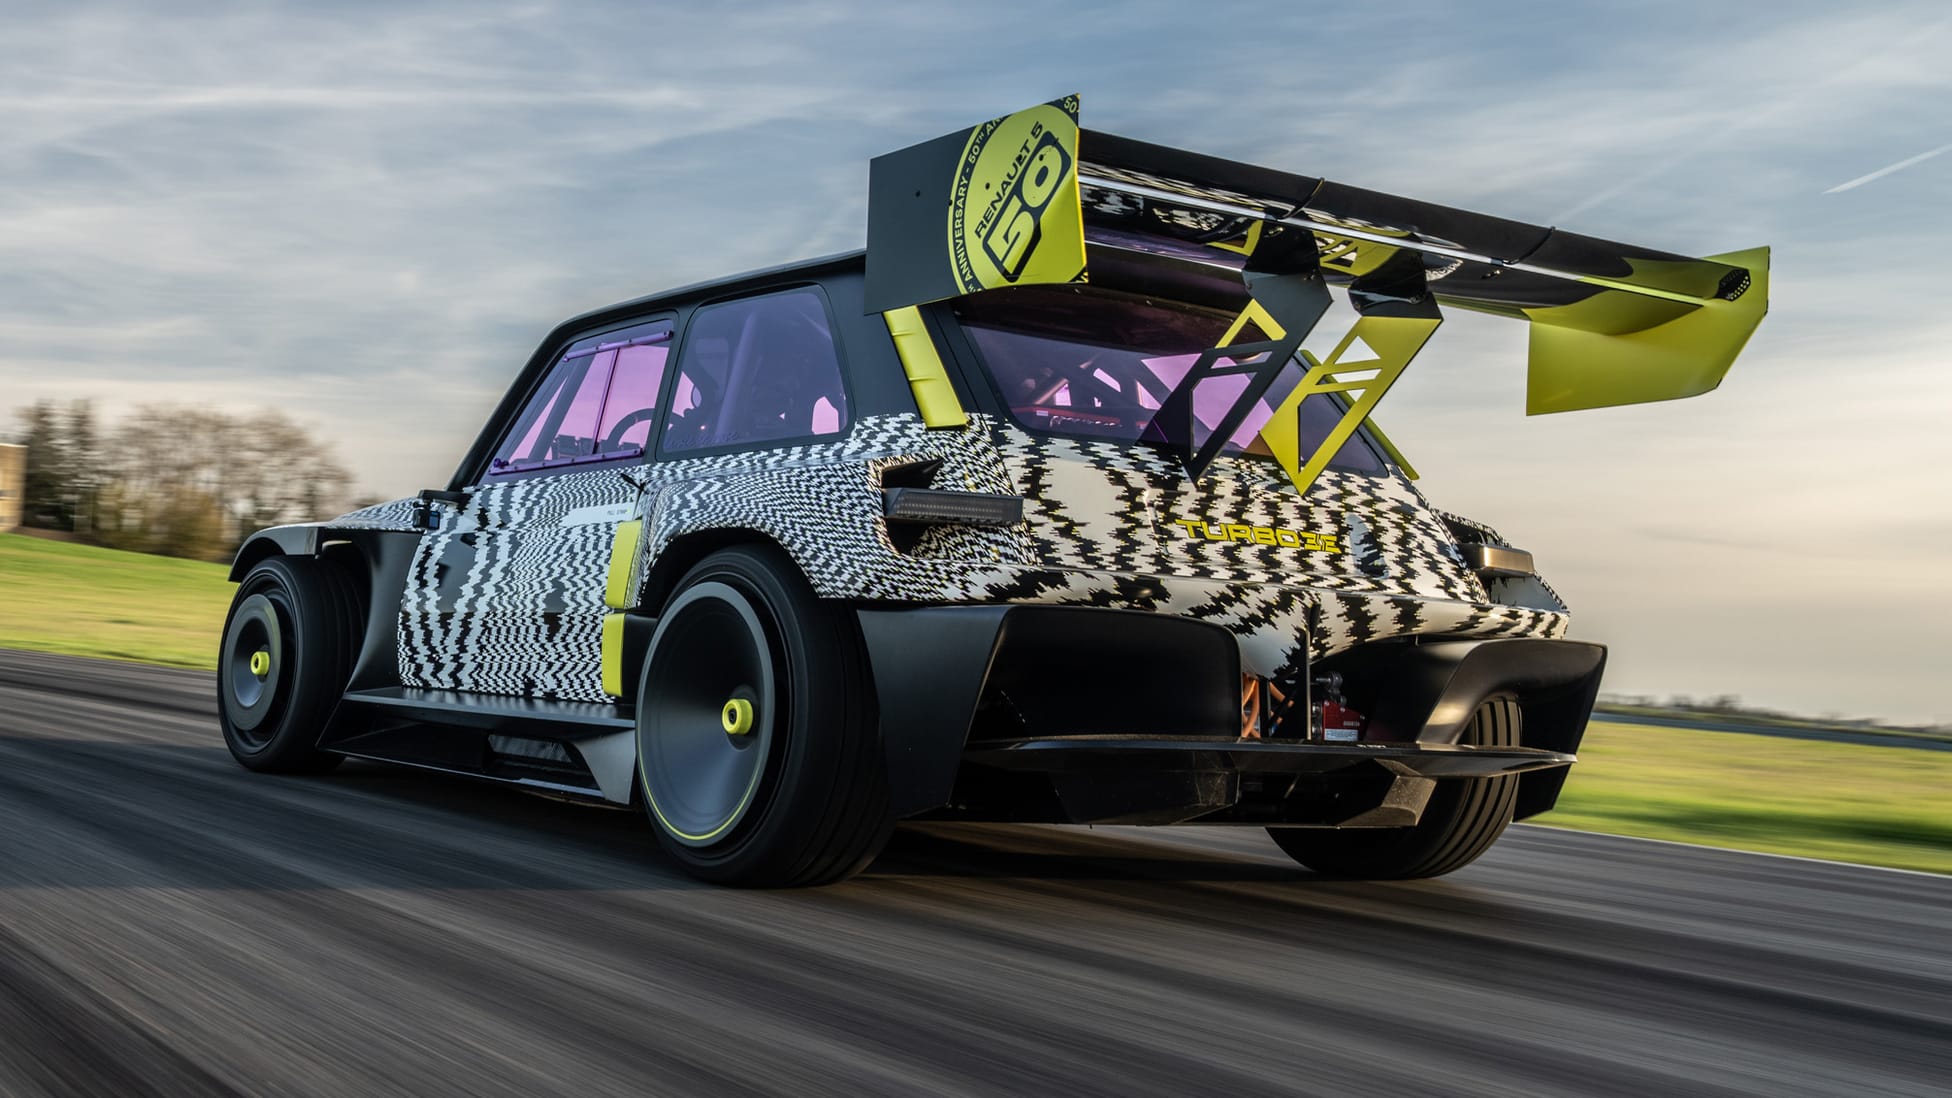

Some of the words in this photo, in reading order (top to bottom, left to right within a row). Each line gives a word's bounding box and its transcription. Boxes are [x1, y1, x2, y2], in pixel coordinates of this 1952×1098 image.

[955, 176, 973, 282] ANNIVERSARY
[968, 132, 985, 164] 50TH
[975, 139, 1031, 239] RENAULT
[1031, 121, 1043, 139] 5
[986, 144, 1063, 275] 50
